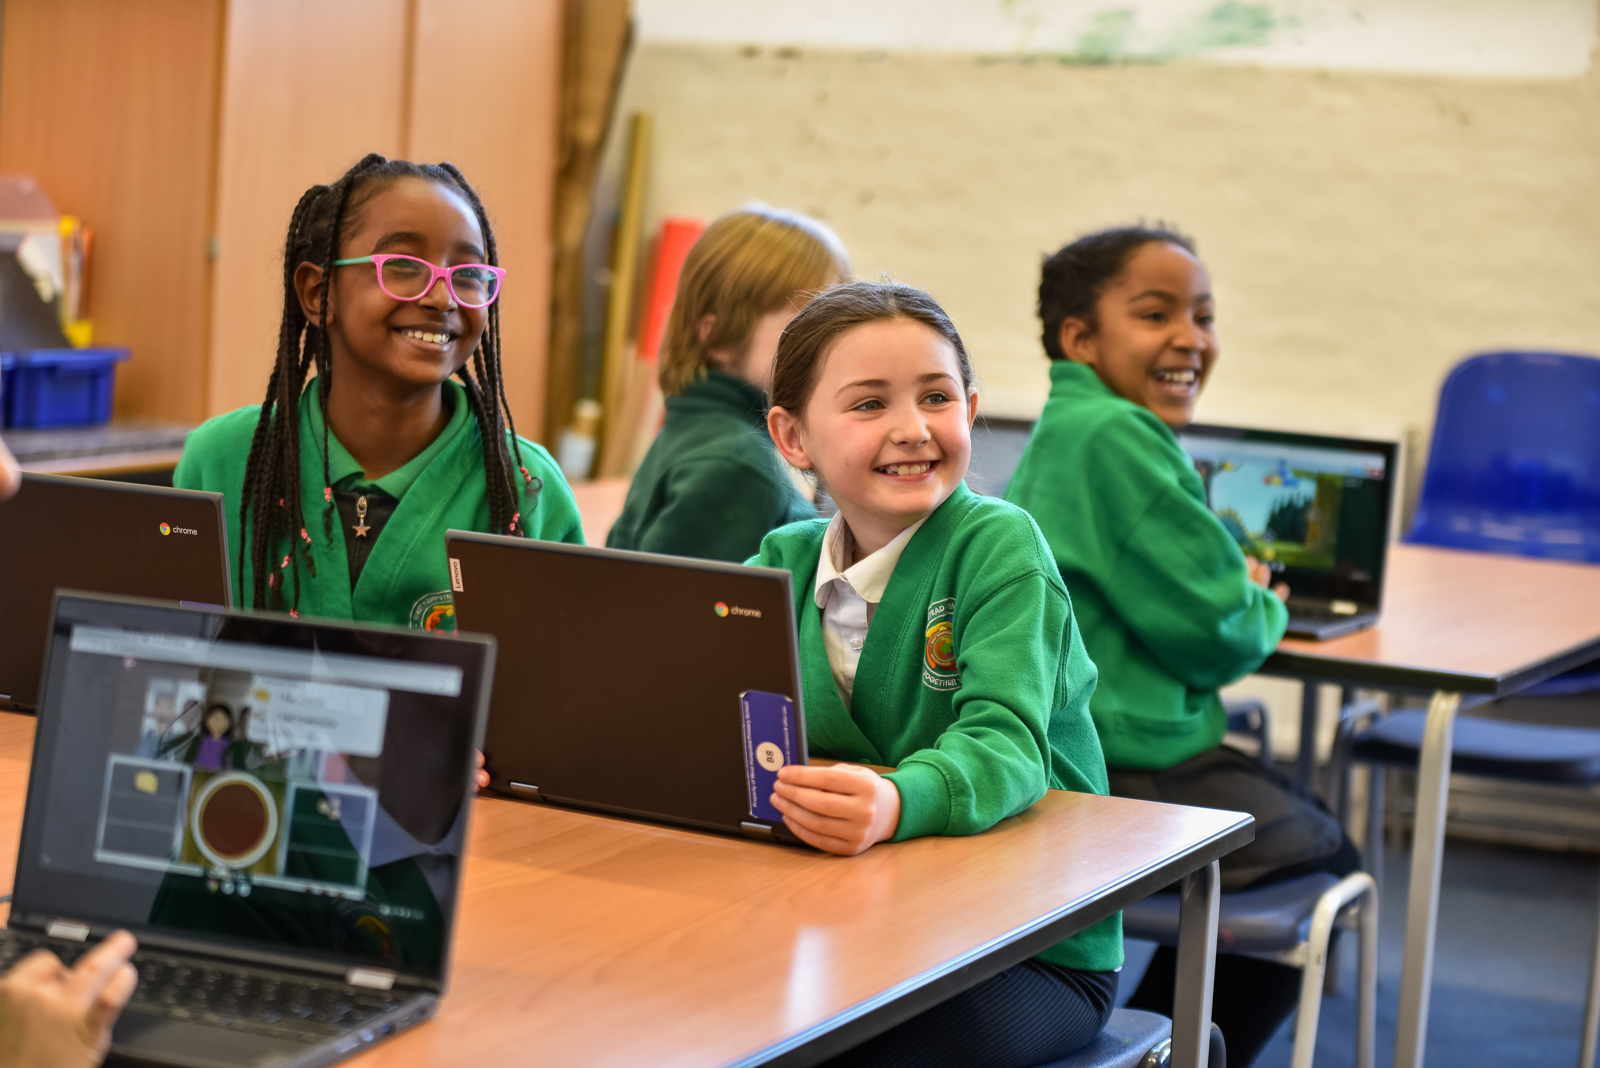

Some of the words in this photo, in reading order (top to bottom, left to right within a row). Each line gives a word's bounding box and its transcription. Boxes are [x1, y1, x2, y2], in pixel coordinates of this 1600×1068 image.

[173, 526, 198, 536] chrome
[453, 561, 461, 589] Lenovo
[730, 605, 762, 618] chrome
[923, 669, 957, 686] TOGETHER
